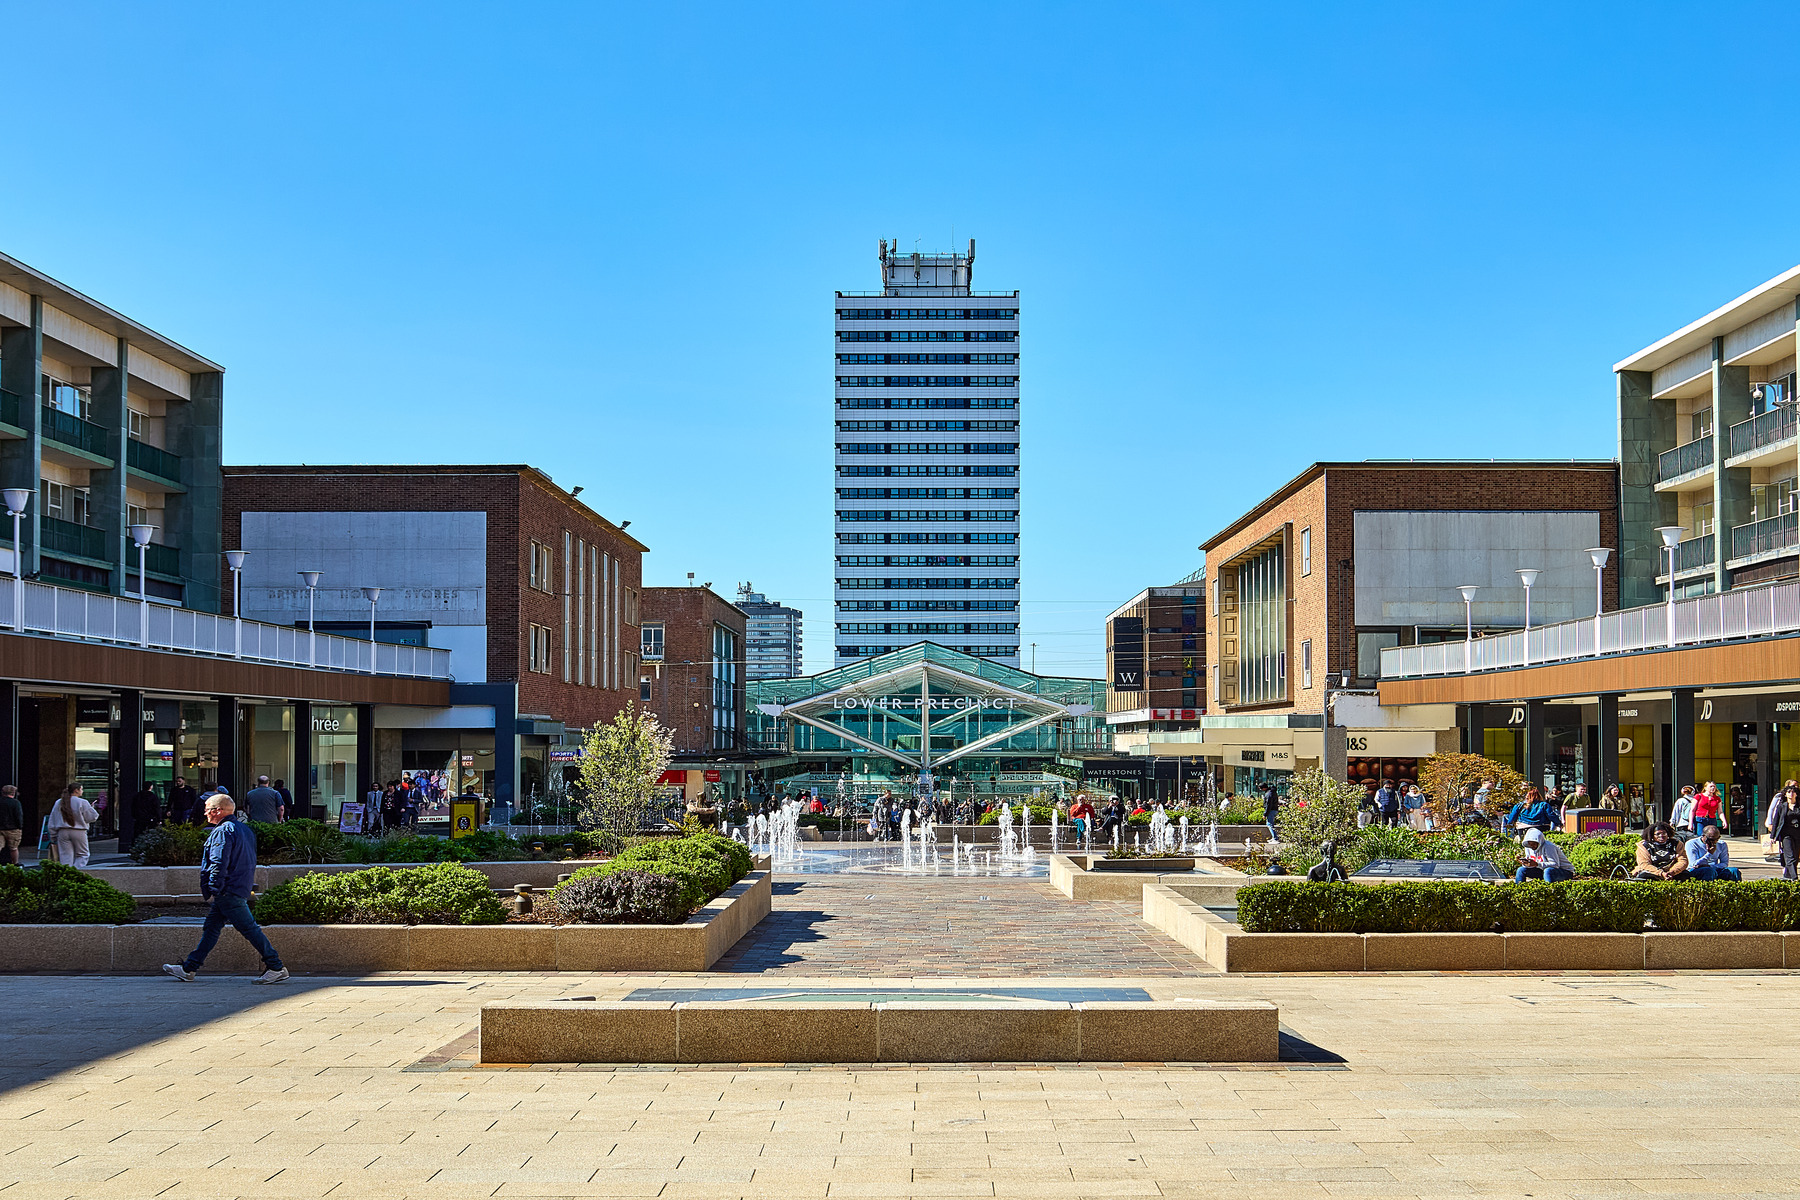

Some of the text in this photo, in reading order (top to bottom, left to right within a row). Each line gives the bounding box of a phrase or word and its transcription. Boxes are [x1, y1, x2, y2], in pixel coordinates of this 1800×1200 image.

[404, 589, 459, 599] STORES
[1119, 673, 1137, 684] W
[833, 697, 1018, 710] LOWER PRECINCT
[1700, 700, 1713, 720] JD
[1508, 708, 1525, 724] JD
